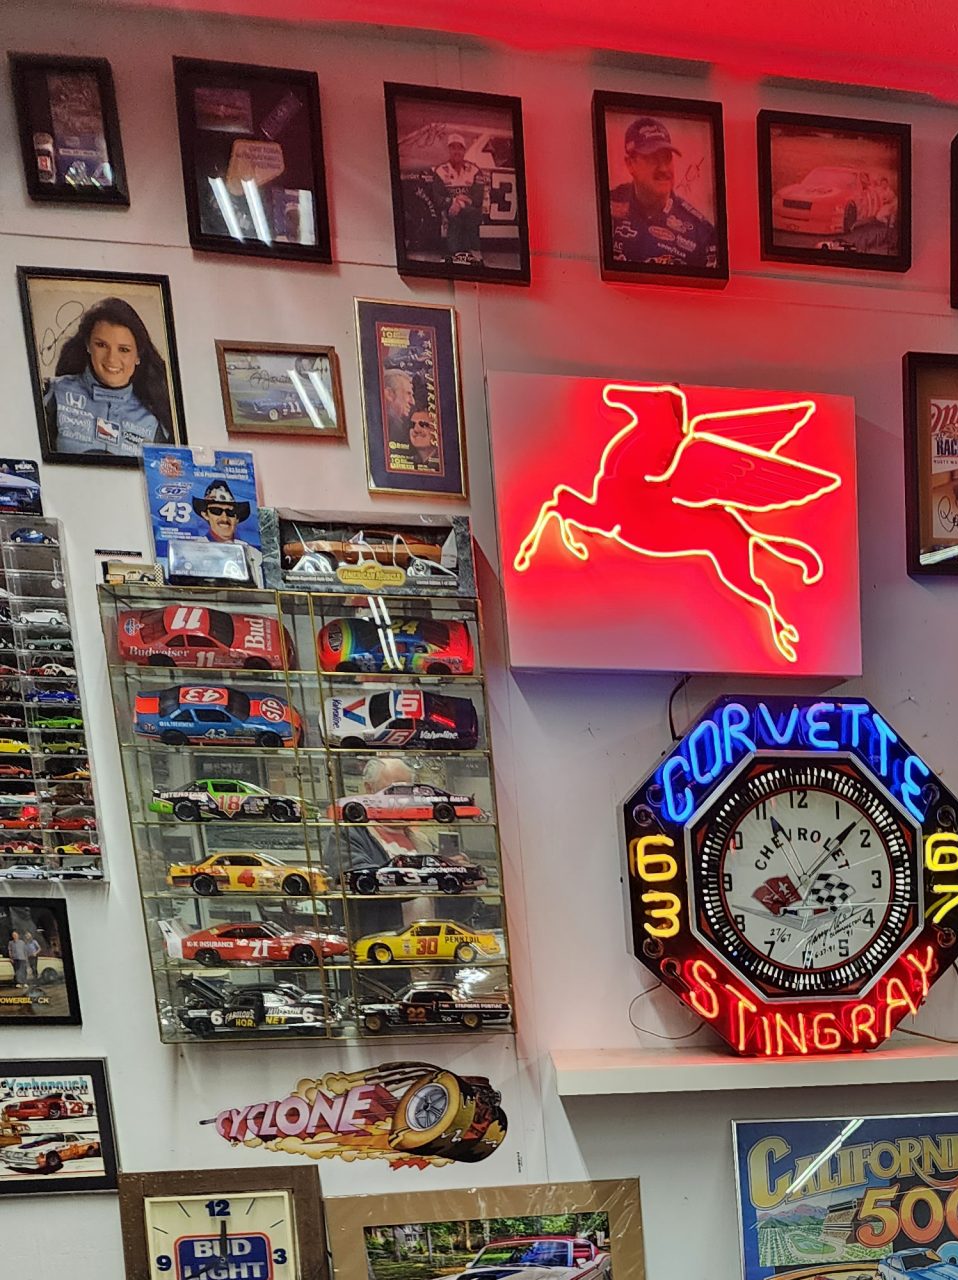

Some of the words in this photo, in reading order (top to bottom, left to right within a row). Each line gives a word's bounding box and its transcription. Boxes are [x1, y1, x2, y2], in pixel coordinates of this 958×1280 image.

[489, 172, 517, 220] 3
[159, 501, 193, 523] 43
[171, 607, 203, 629] 11
[244, 617, 265, 650] Bud
[129, 645, 190, 658] Budweiser
[196, 652, 215, 667] 11
[183, 688, 222, 701] 43
[262, 700, 285, 721] STP
[205, 728, 227, 740] 43
[420, 730, 459, 740] Valvoline
[662, 702, 929, 823] CORVETTE
[218, 794, 240, 811] 18
[789, 790, 808, 809] 12
[755, 803, 767, 820] 11
[860, 830, 871, 848] 2
[755, 827, 850, 870] CHEVROLET
[237, 869, 256, 888] 4
[402, 872, 422, 884] 3
[871, 870, 882, 888] 3
[734, 914, 746, 932] 8
[862, 909, 875, 928] 4
[416, 937, 439, 956] 30
[764, 940, 775, 958] 7
[838, 938, 849, 957] 5
[689, 945, 934, 1056] STINGRAY
[211, 1010, 223, 1025] 6
[302, 1007, 314, 1022] 6
[7, 1077, 88, 1092] Yarborough
[215, 1084, 379, 1141] CYCLONE
[205, 1200, 231, 1217] 12
[194, 1239, 252, 1258] BUD
[273, 1248, 287, 1264] 3
[156, 1254, 172, 1271] 9
[184, 1261, 265, 1280] LIGHT
